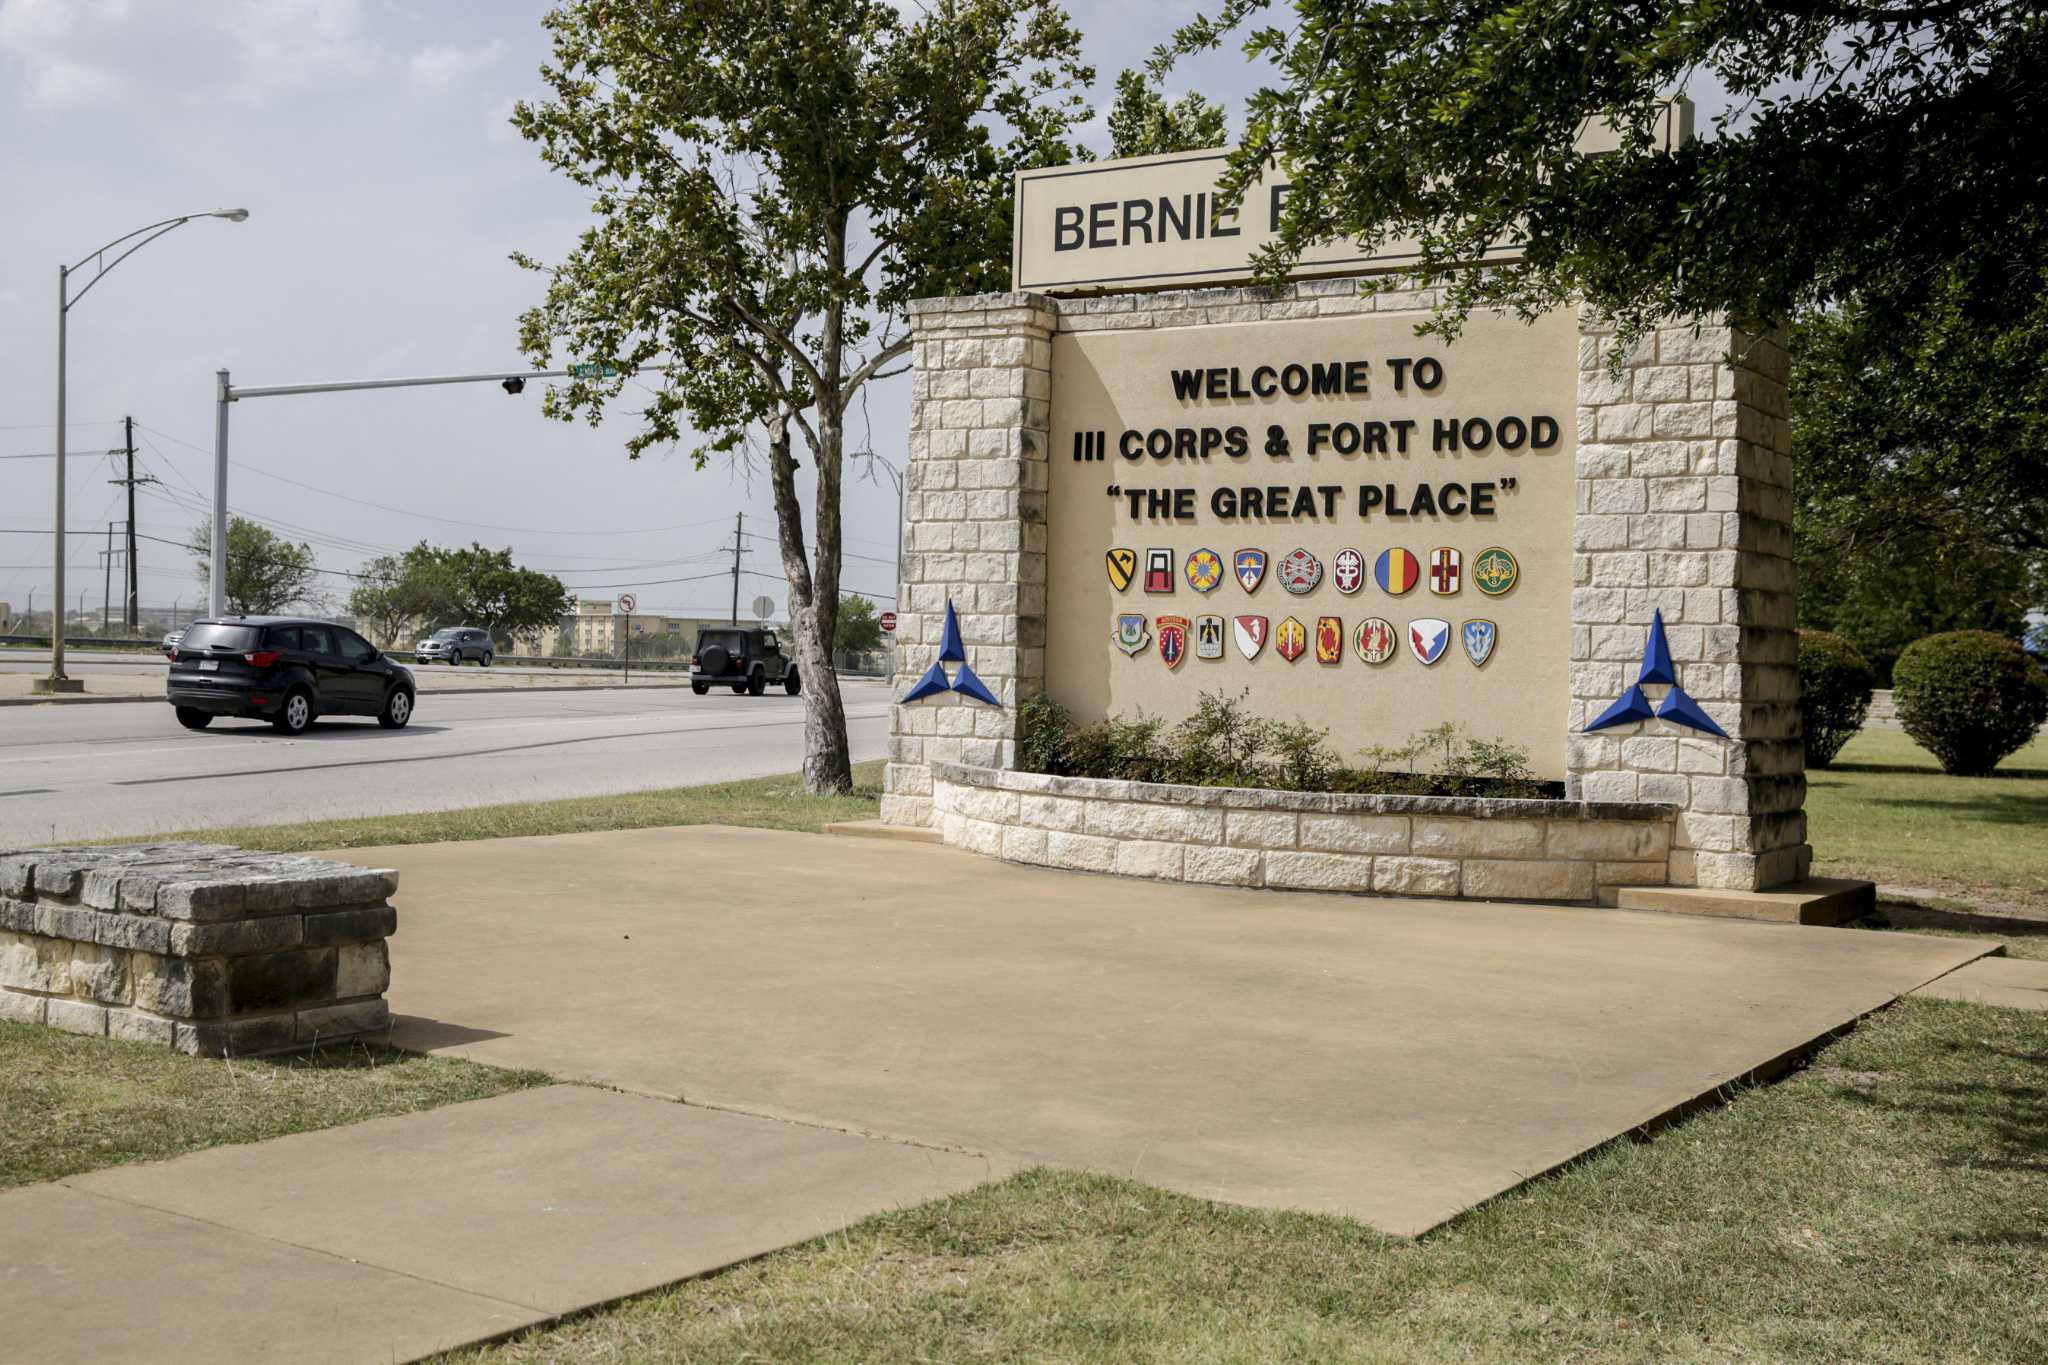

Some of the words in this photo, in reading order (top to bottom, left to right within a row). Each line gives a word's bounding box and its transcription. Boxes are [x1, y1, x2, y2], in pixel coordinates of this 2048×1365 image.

[1054, 191, 1241, 252] BERNIE
[1171, 361, 1369, 400] WELCOME
[1386, 356, 1443, 391] TO
[1073, 431, 1106, 462] III
[1119, 426, 1249, 461] CORPS
[1264, 424, 1291, 458] &
[1307, 420, 1416, 456] FORT
[1432, 415, 1560, 452] HOOD
[1210, 485, 1343, 519] GREAT
